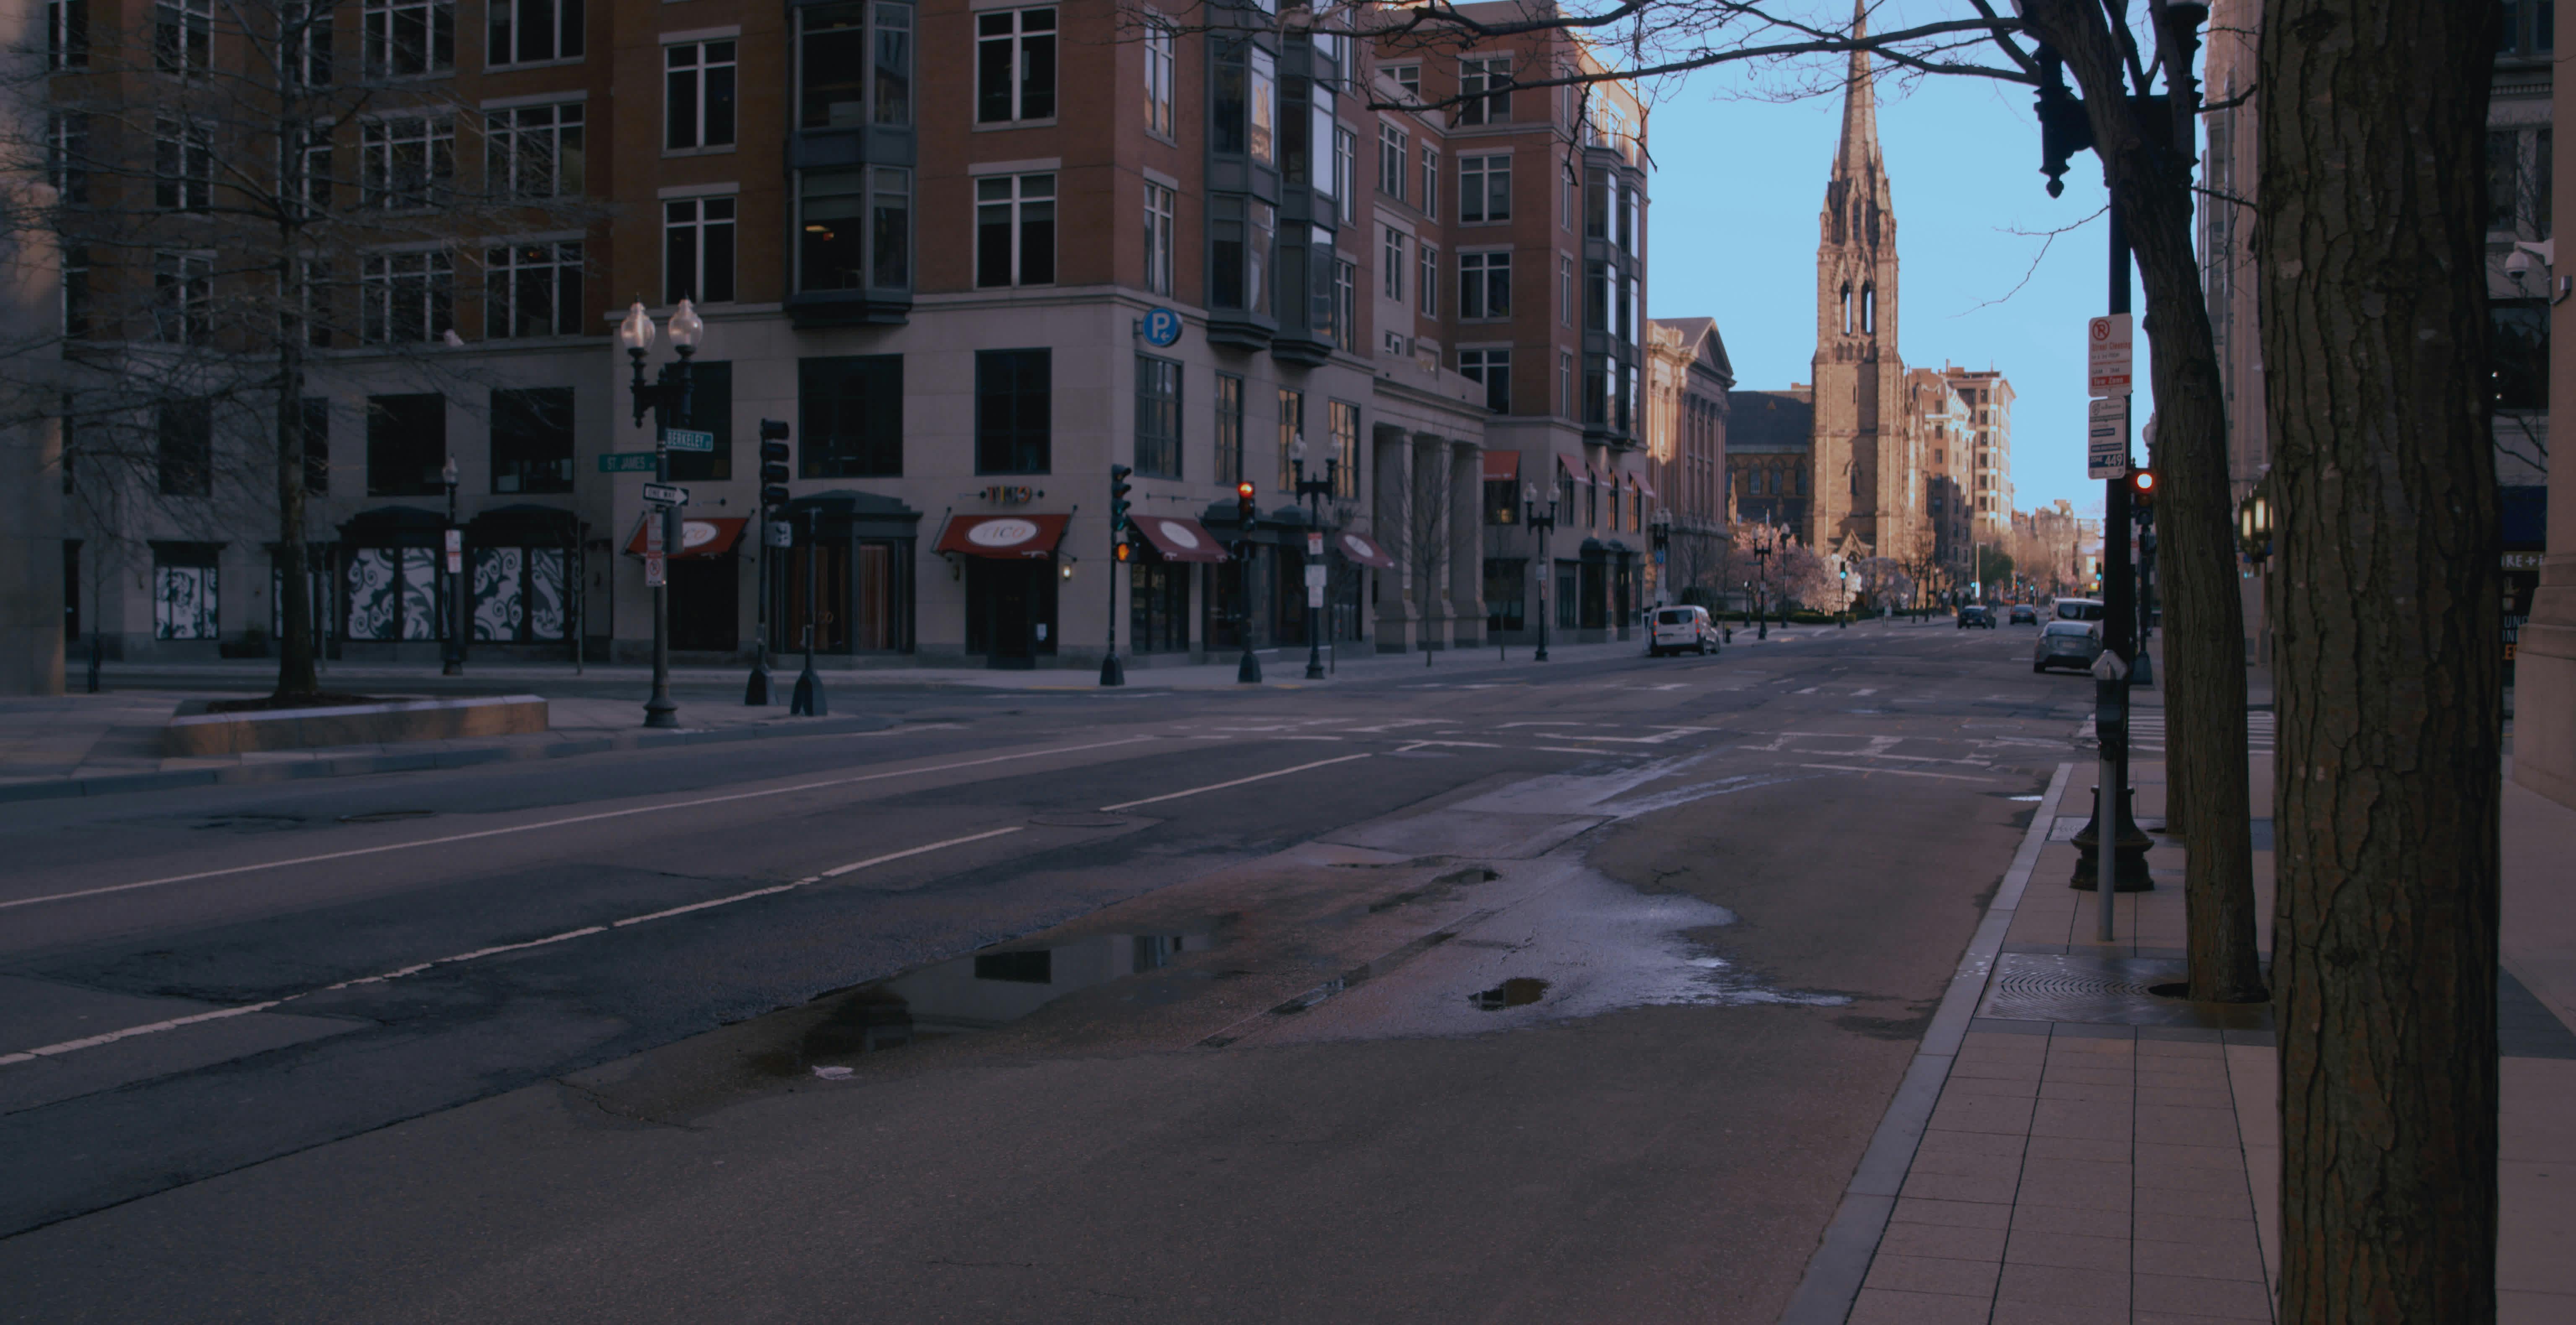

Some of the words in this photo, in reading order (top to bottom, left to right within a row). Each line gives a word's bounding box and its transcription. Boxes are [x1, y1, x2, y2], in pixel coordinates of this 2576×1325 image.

[1152, 313, 1170, 338] P
[667, 431, 704, 447] BERKELEY
[607, 456, 618, 470] ST.
[620, 455, 645, 470] JAMES
[2105, 453, 2123, 466] 449
[649, 488, 660, 498] ONE
[987, 485, 1032, 503] TICO
[981, 526, 1027, 539] TICO
